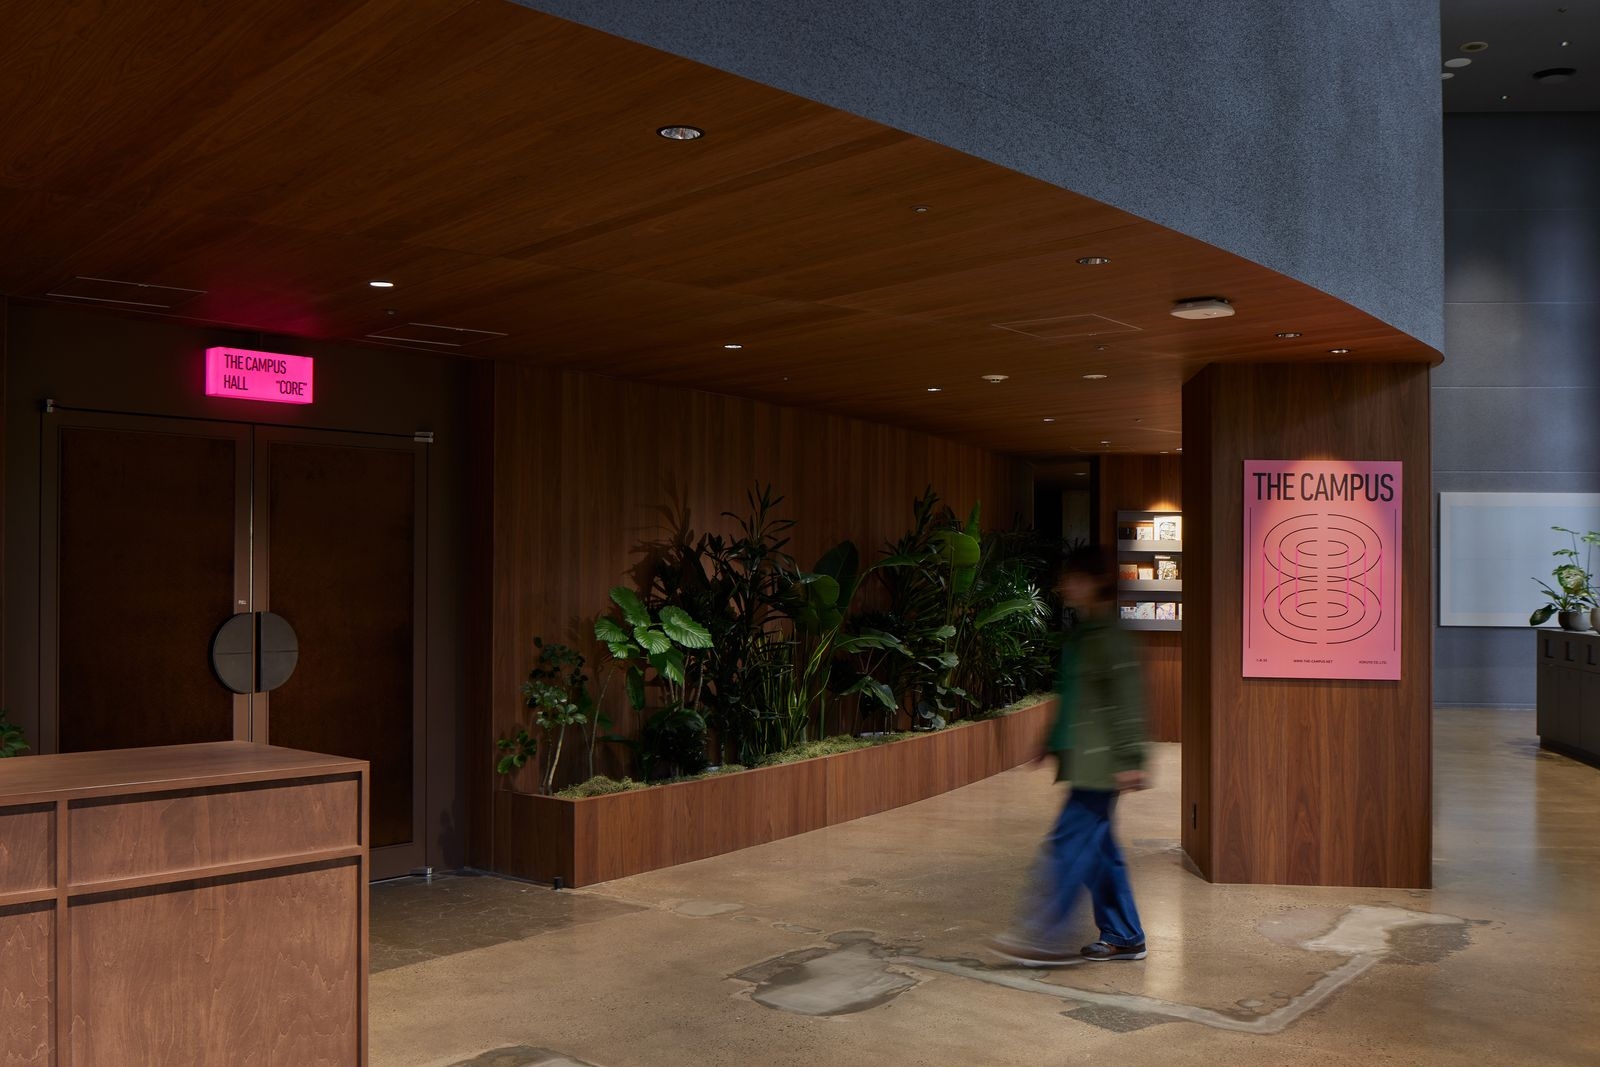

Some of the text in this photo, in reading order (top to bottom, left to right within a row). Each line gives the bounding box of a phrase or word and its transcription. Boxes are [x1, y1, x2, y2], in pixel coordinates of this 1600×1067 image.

[224, 354, 287, 375] THE CAMPUS
[224, 374, 248, 391] HALL
[1252, 472, 1394, 502] THE CAMPUS
